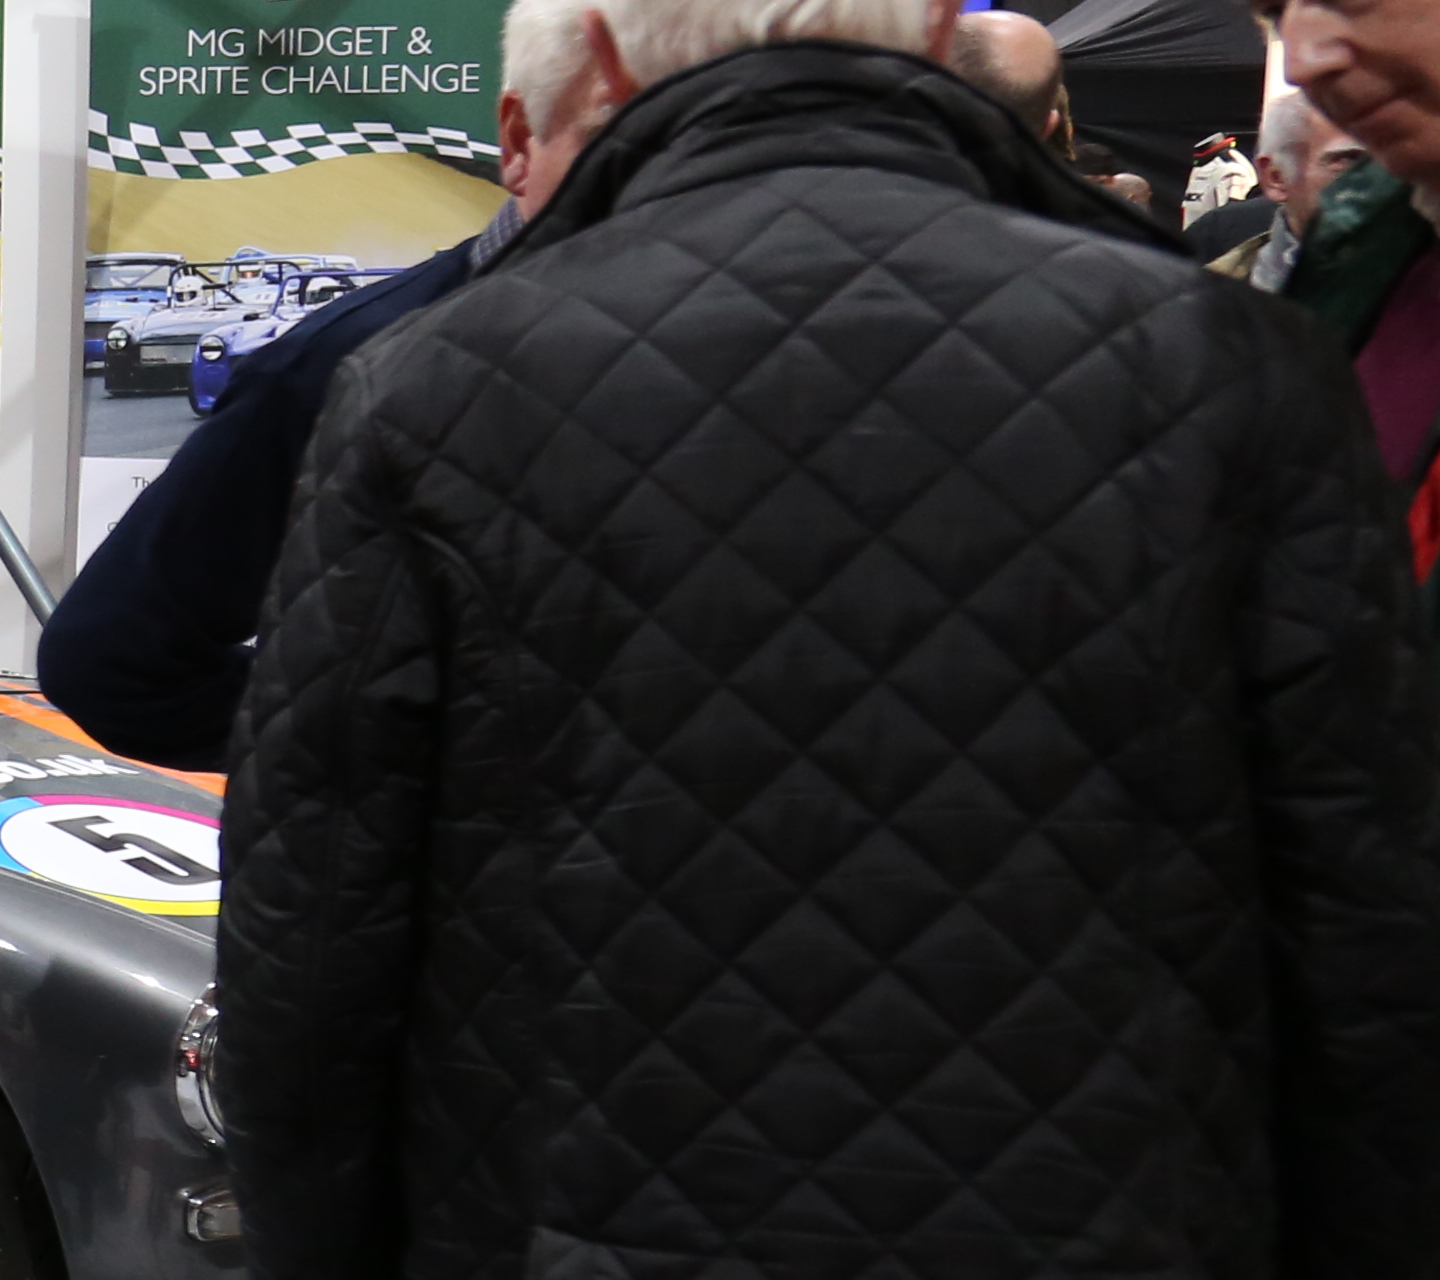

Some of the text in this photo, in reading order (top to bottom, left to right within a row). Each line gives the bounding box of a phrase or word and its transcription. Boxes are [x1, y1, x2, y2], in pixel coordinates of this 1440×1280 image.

[187, 26, 433, 58] MG MIDGET &
[140, 63, 481, 96] SPRITE CHALLENGE
[47, 814, 222, 886] 5
